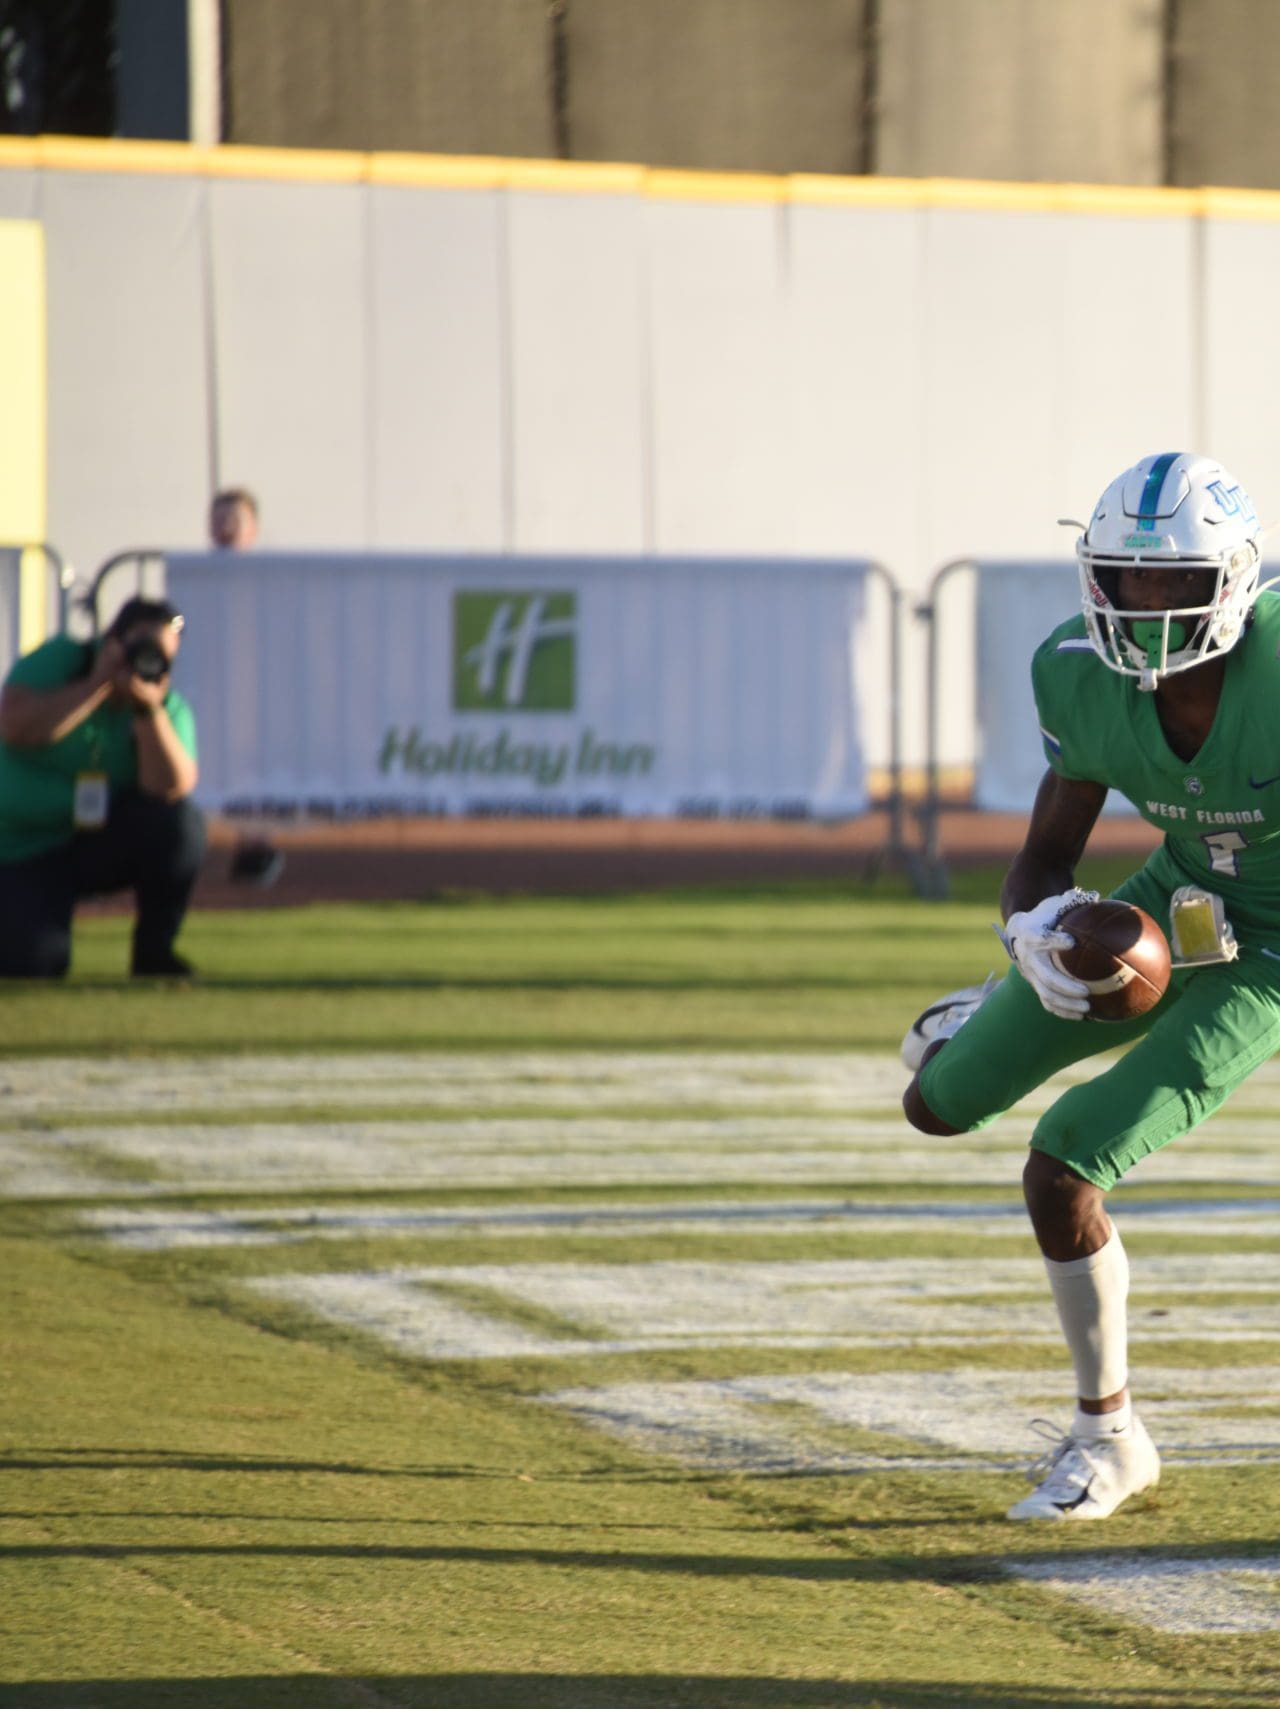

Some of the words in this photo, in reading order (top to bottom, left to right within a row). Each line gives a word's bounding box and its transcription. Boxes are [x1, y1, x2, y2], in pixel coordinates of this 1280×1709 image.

[378, 726, 569, 787] Holiday
[575, 727, 656, 777] Inn
[1145, 800, 1187, 820] WEST
[1196, 809, 1265, 824] FLORIDA
[1201, 830, 1248, 880] 1
